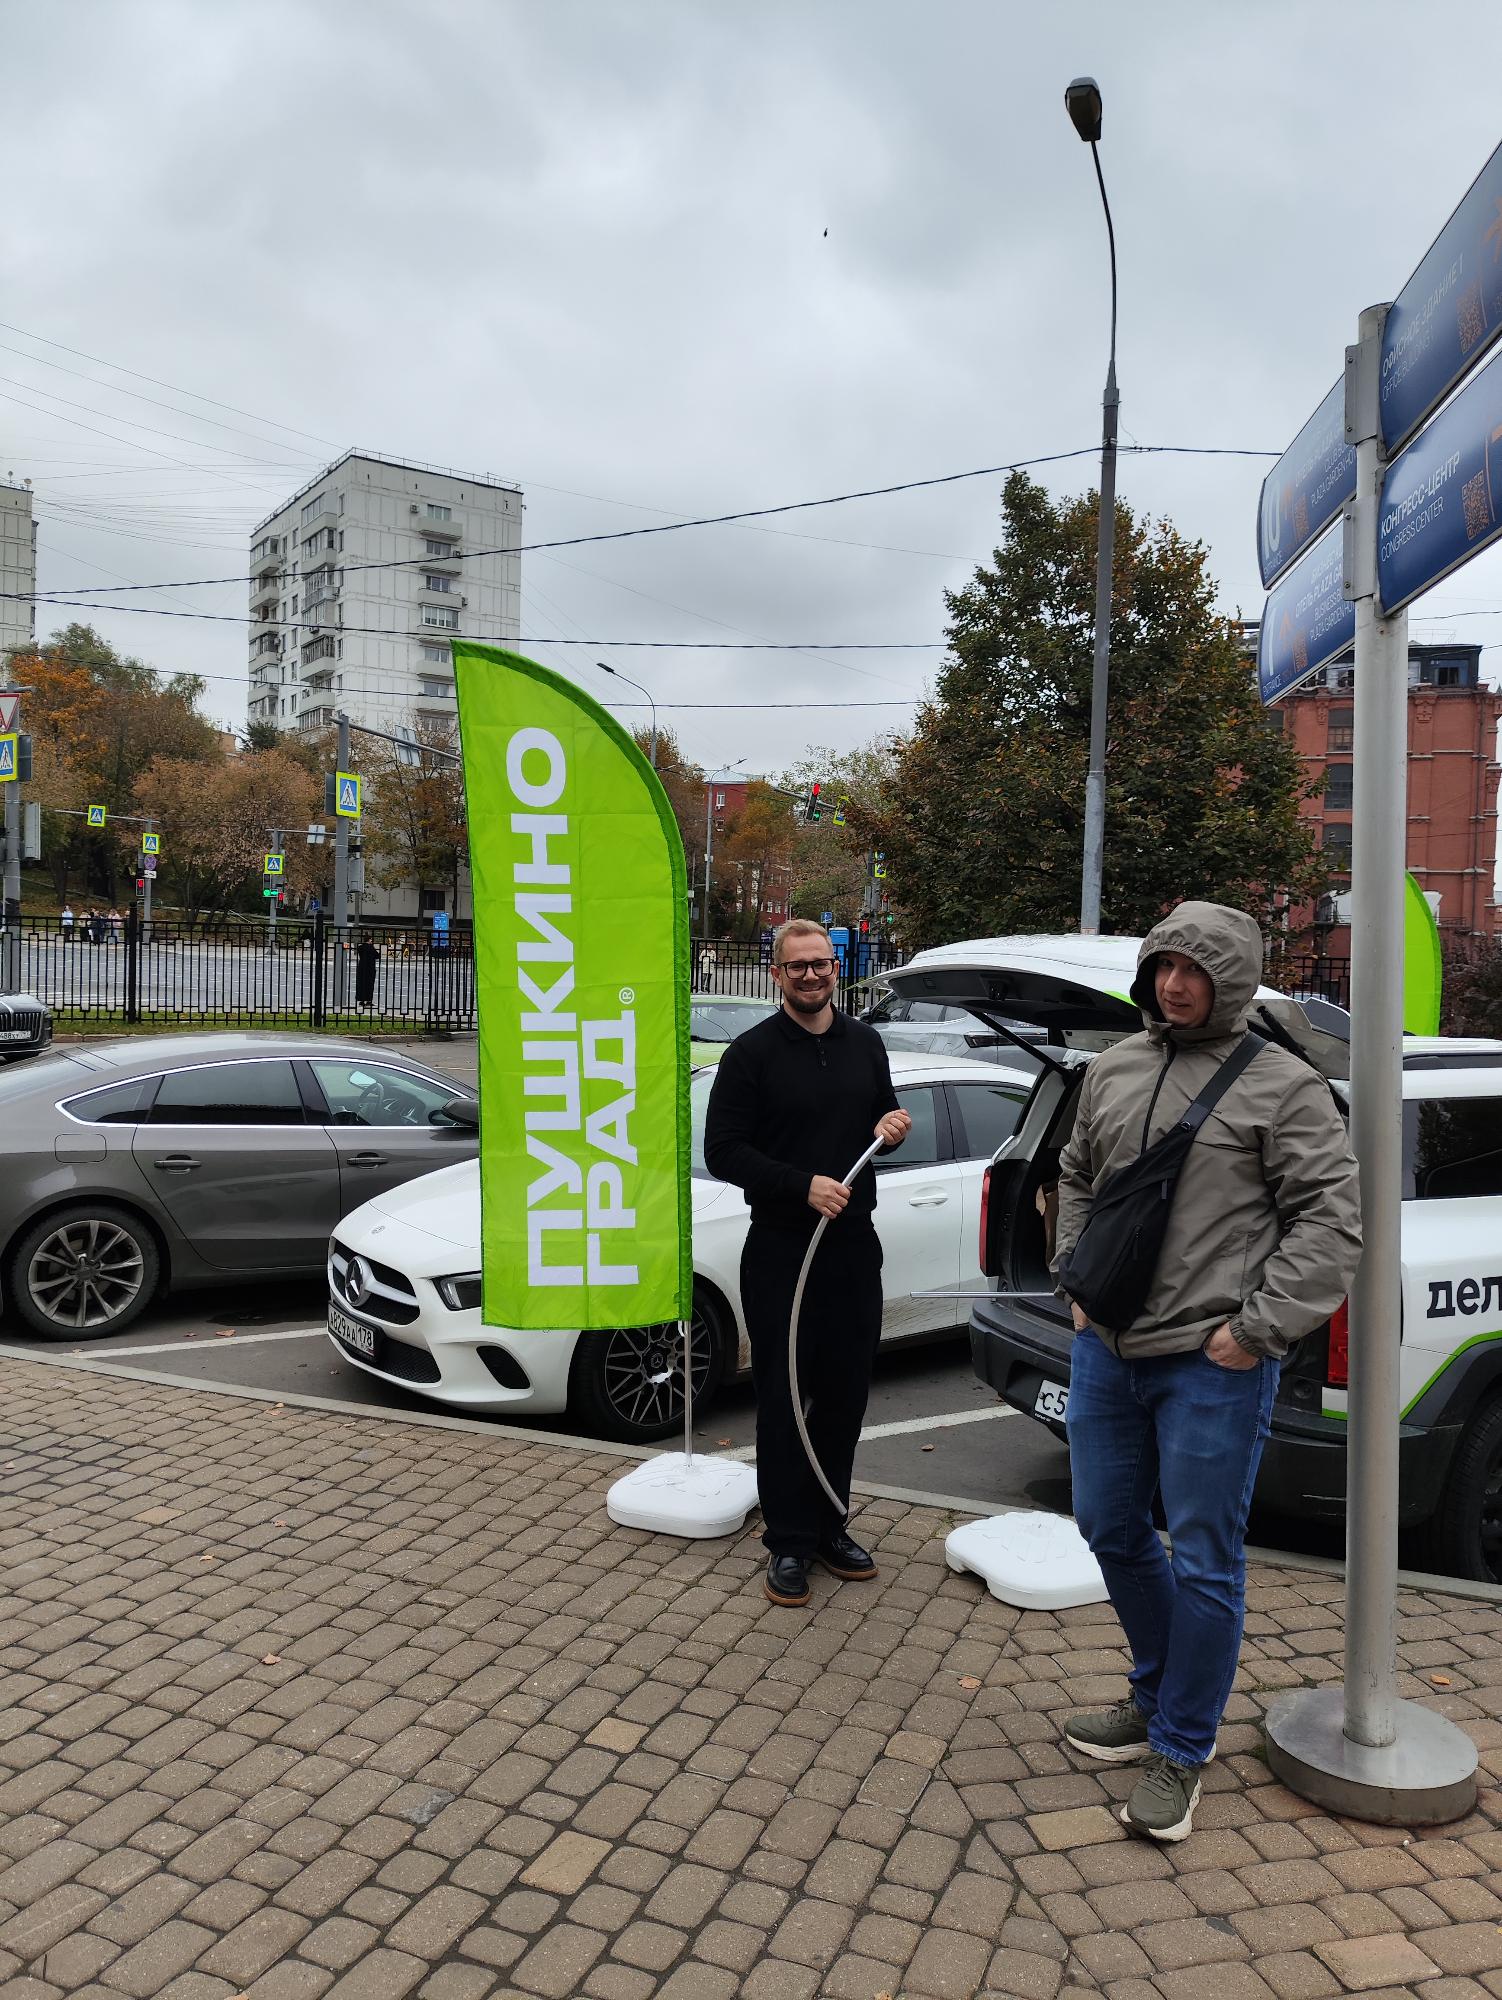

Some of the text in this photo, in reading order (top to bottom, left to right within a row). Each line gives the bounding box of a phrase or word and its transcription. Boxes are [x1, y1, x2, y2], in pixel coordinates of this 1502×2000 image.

[1380, 450, 1460, 540] КОНГРЕСС-ЦЕНТР
[1380, 496, 1445, 562] CONGRESS CENTER
[505, 726, 583, 1287] ПУШКИНО
